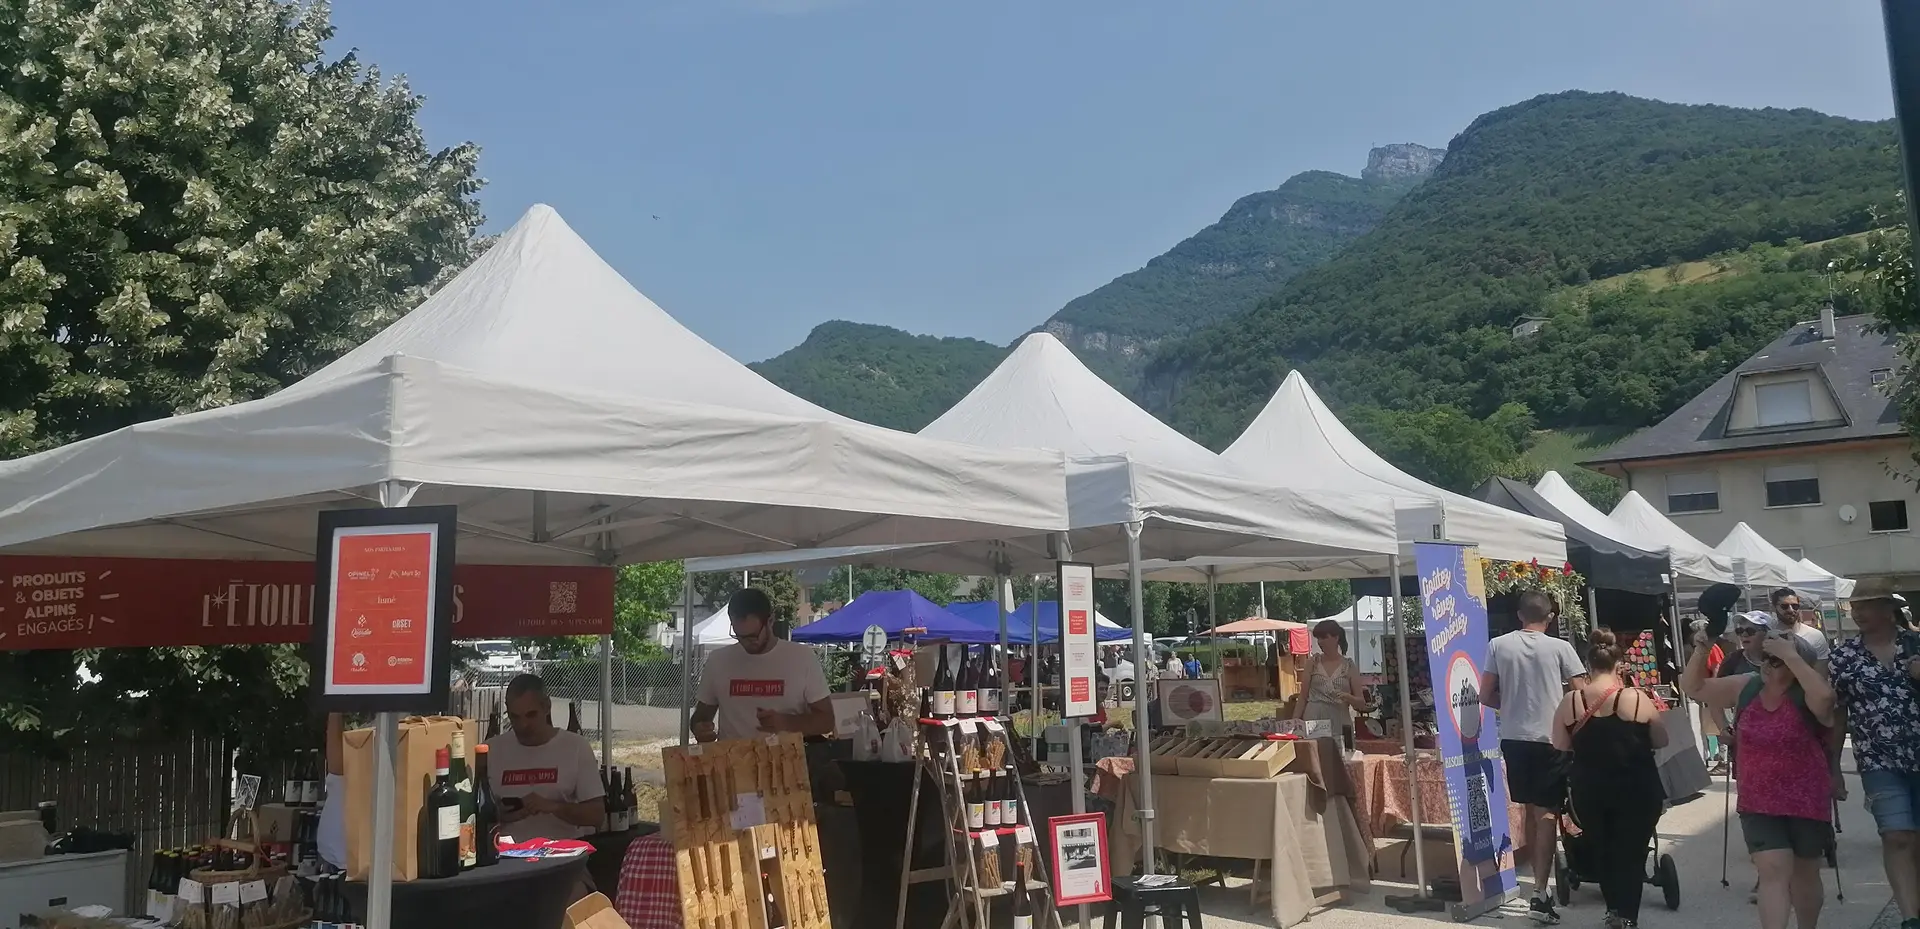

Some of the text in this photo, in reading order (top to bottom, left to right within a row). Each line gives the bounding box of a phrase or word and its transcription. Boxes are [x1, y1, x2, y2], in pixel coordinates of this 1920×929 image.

[13, 571, 86, 588] PRODUITS
[1422, 567, 1451, 606] Goûtez
[15, 587, 84, 604] & OBJETS
[24, 603, 77, 619] ALPINS
[17, 616, 84, 636] ENGAGÉS
[392, 619, 412, 629] ORSET
[1431, 612, 1467, 656] appréciez
